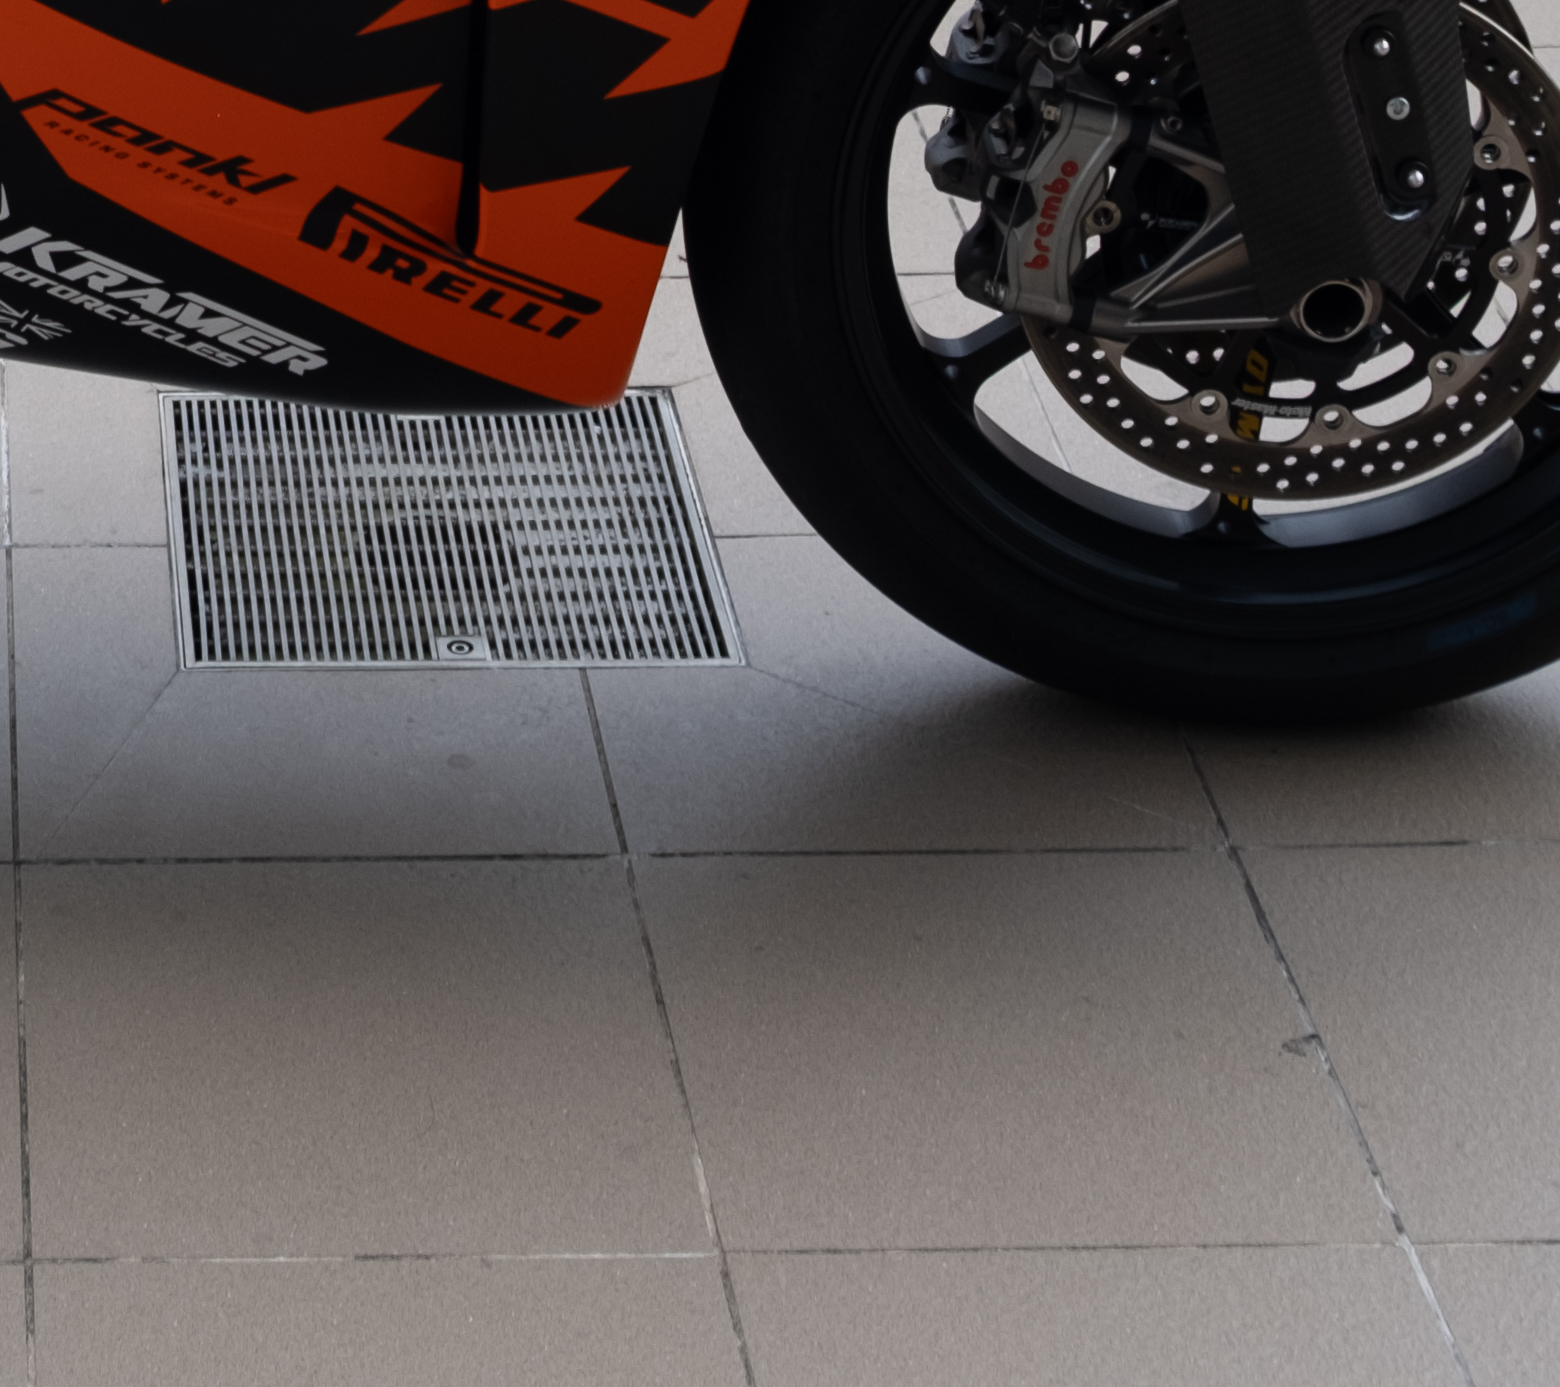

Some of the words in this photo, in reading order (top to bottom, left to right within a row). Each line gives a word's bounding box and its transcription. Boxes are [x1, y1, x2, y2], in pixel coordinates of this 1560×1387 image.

[43, 119, 130, 161] RACING
[136, 159, 238, 207] SYSTEMS
[1023, 159, 1079, 271] brembo
[297, 184, 603, 340] PIRELLI
